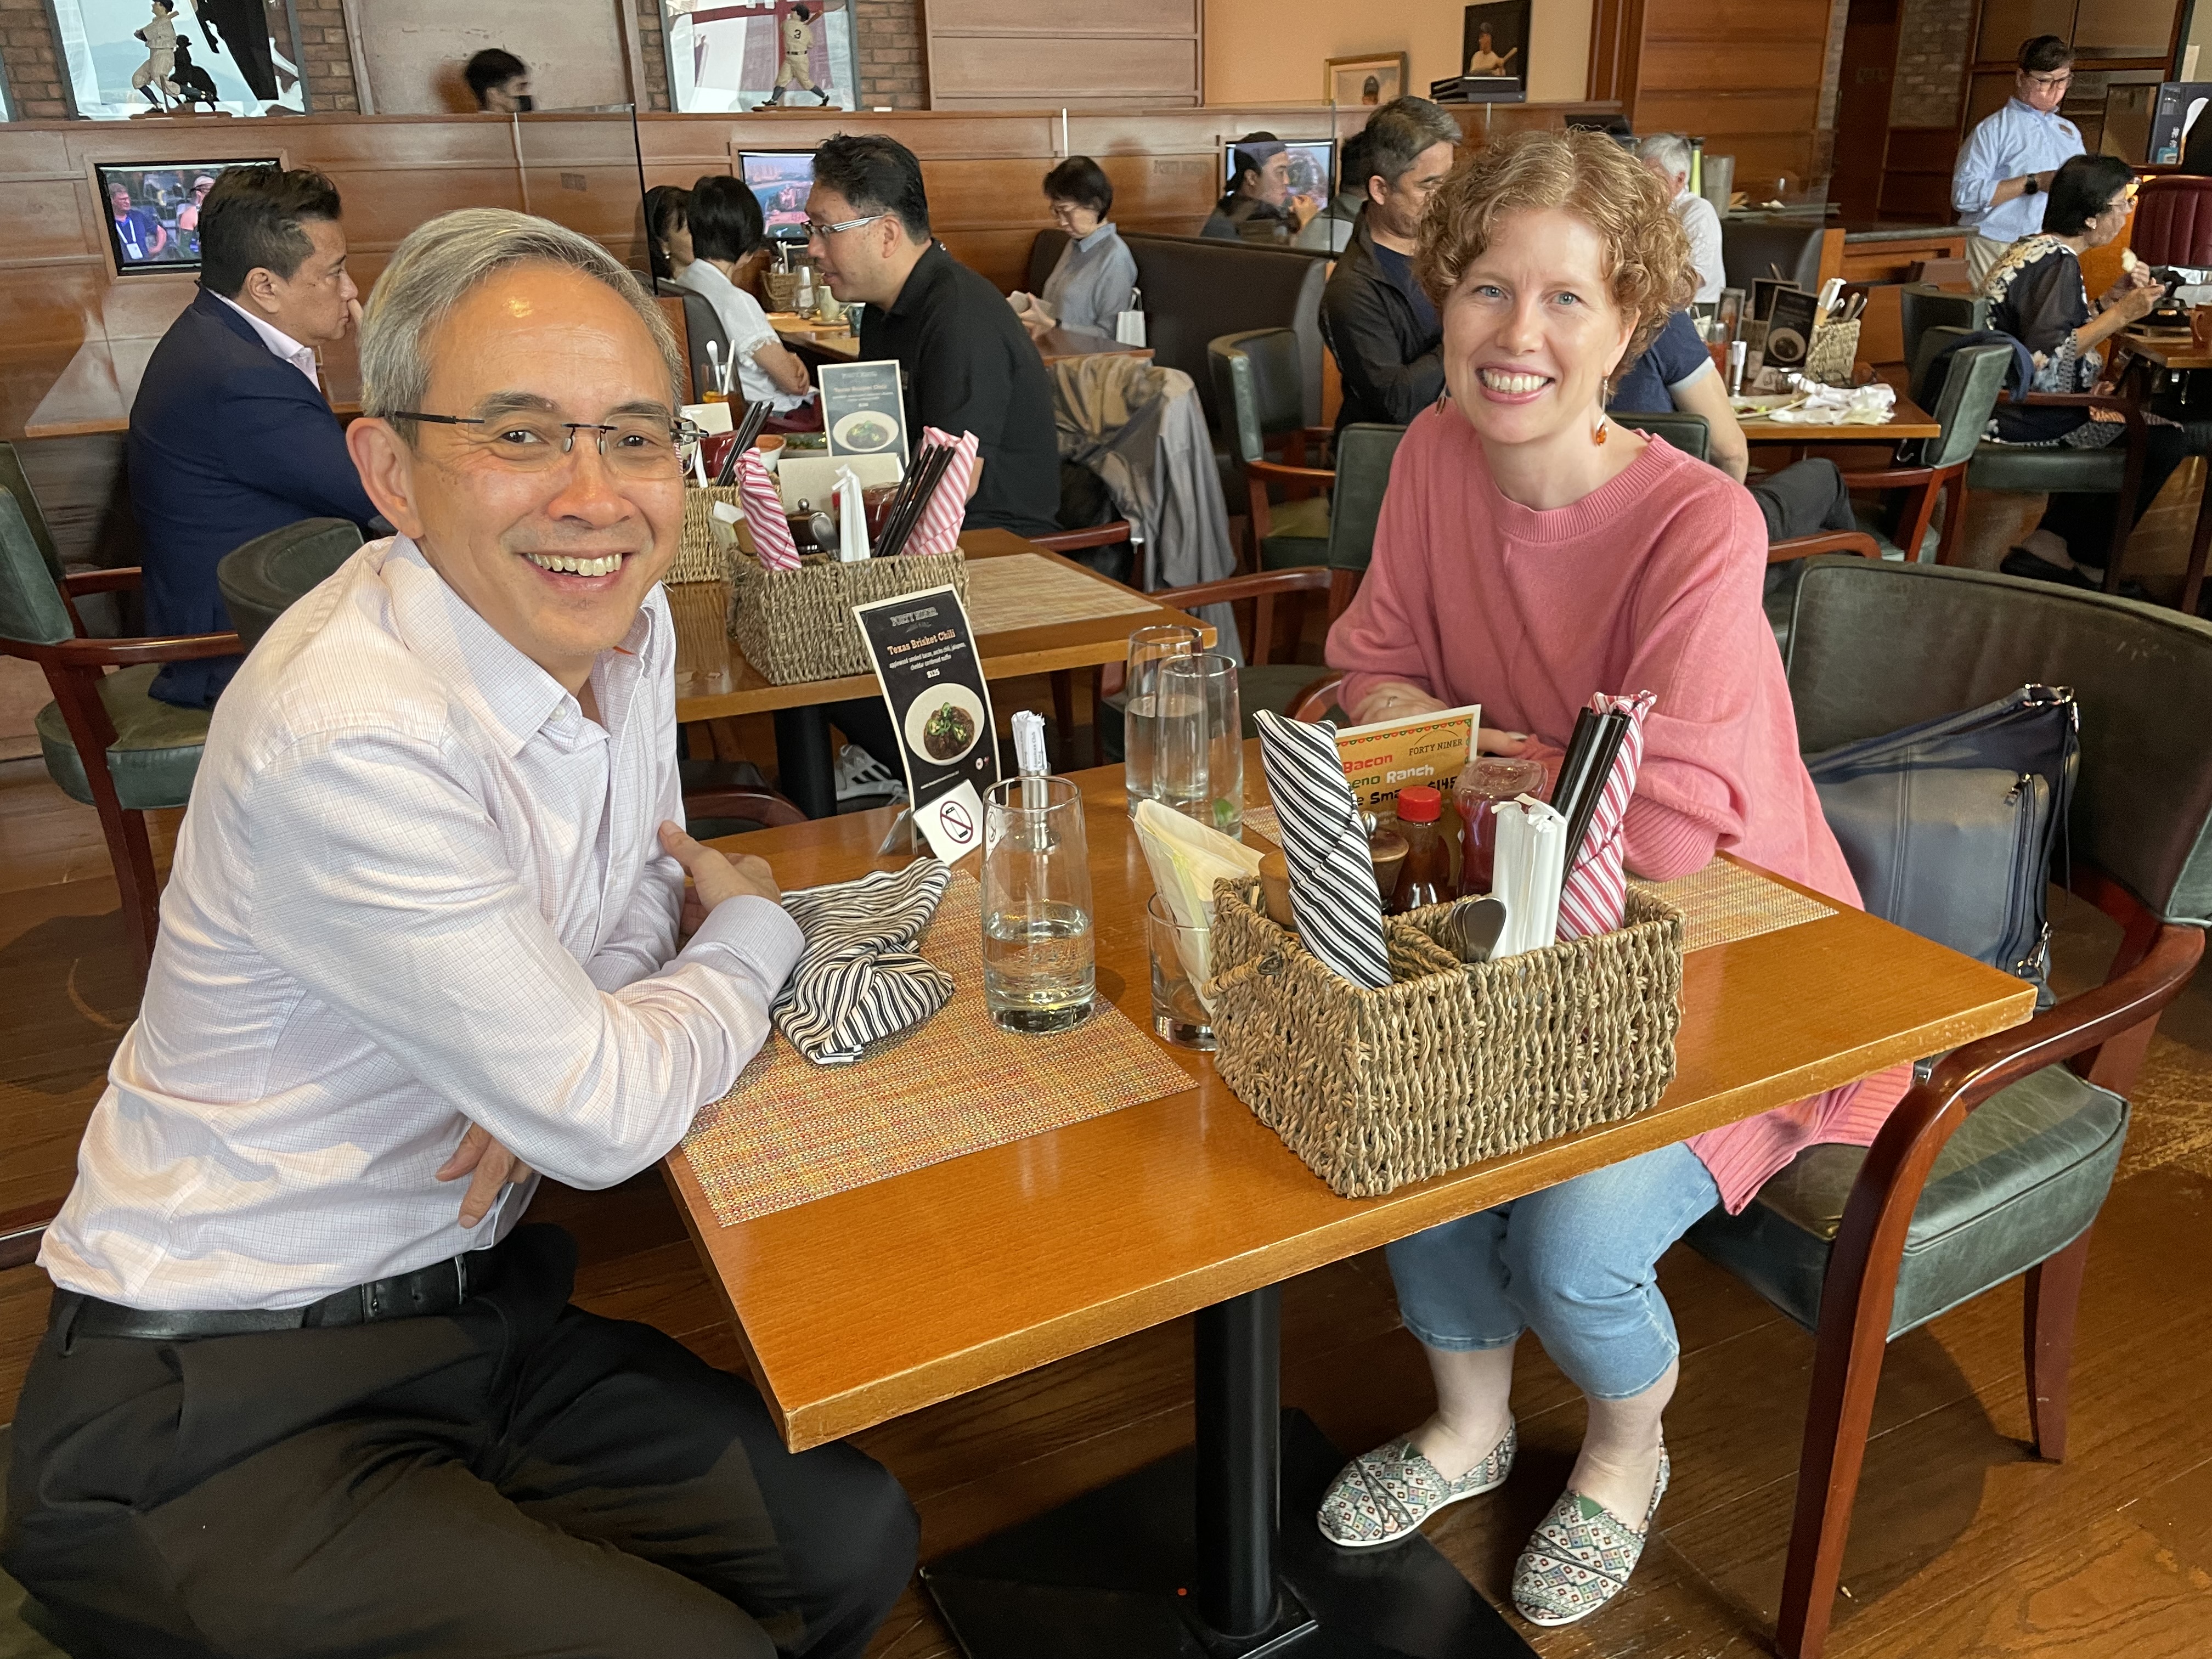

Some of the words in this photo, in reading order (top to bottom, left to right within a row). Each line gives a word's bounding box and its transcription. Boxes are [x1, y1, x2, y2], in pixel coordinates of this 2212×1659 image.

[794, 29, 802, 39] 3
[887, 642, 911, 655] Texas
[911, 634, 938, 648] Brisket
[938, 629, 956, 641] Chili
[1409, 744, 1435, 756] FORTY
[1437, 738, 1463, 751] NINER
[1342, 754, 1393, 774] Bacon
[1386, 764, 1434, 783] Ranch
[1370, 788, 1402, 805] Sma
